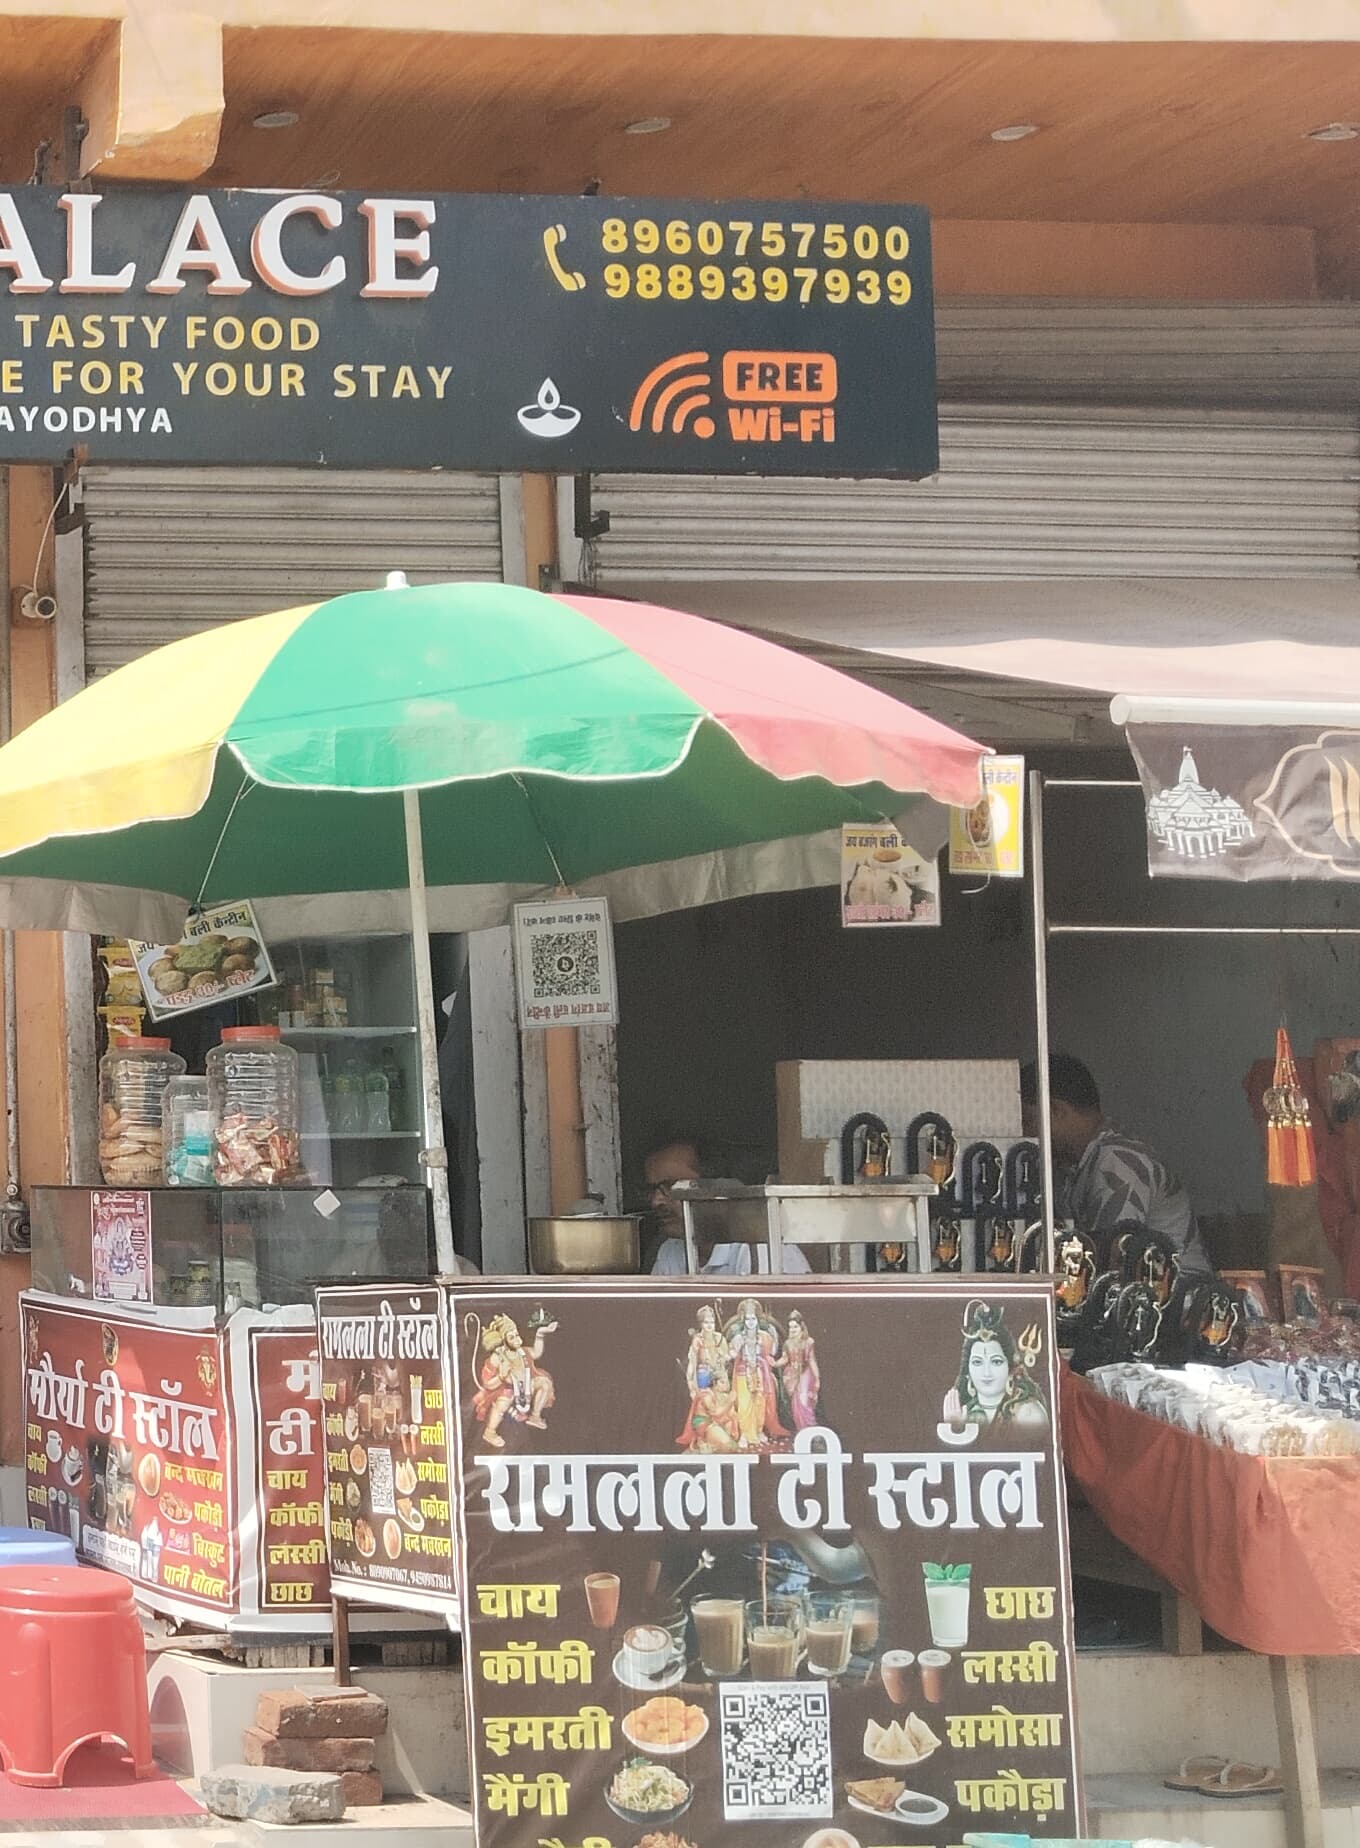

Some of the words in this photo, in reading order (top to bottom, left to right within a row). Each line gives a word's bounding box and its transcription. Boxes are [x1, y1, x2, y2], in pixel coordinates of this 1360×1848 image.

[601, 218, 910, 261] 8960757500
[604, 263, 912, 305] 9889397939
[15, 314, 169, 352] TASTY
[186, 315, 321, 352] FOOD
[53, 359, 146, 396] FOR
[172, 361, 306, 397] YOUR
[333, 363, 454, 400] STAY
[735, 360, 824, 393] FREE
[727, 407, 837, 444] Wi-Fi
[377, 1299, 396, 1359] टी
[396, 1297, 440, 1359] स्टॉल
[92, 1369, 126, 1439] टी
[129, 1379, 220, 1461] स्टॉल
[266, 1407, 317, 1456] टी
[266, 1469, 309, 1490] चाय
[474, 1453, 760, 1533] रामलला
[770, 1426, 853, 1531] टी
[863, 1422, 1046, 1530] स्टॉल
[269, 1501, 324, 1527] कॉफी
[270, 1582, 314, 1603] छाछ
[476, 1584, 561, 1618] चाय
[983, 1586, 1056, 1620] छाछ
[479, 1640, 596, 1684] कॉफी
[961, 1640, 1058, 1684] लस्सी
[482, 1706, 614, 1757] इमरती
[945, 1704, 1063, 1748] समोसा
[953, 1769, 1067, 1822] पकौड़ा
